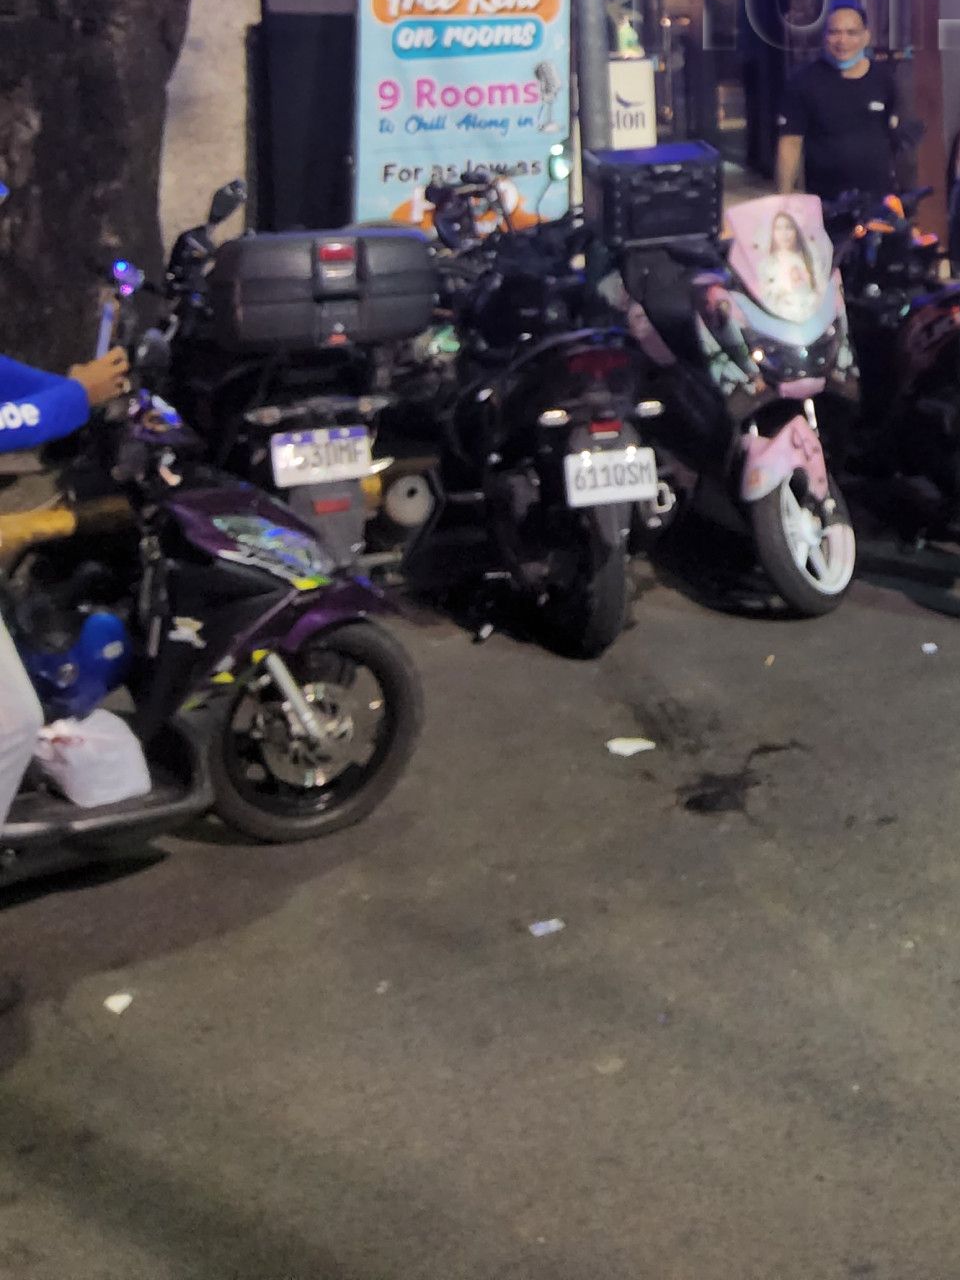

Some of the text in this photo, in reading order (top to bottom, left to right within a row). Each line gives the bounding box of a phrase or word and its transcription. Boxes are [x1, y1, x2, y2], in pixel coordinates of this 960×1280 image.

[396, 22, 537, 50] on rooms
[377, 77, 541, 112] 9 Rooms
[404, 114, 448, 134] Chill
[382, 162, 424, 184] For
[516, 160, 542, 176] as
